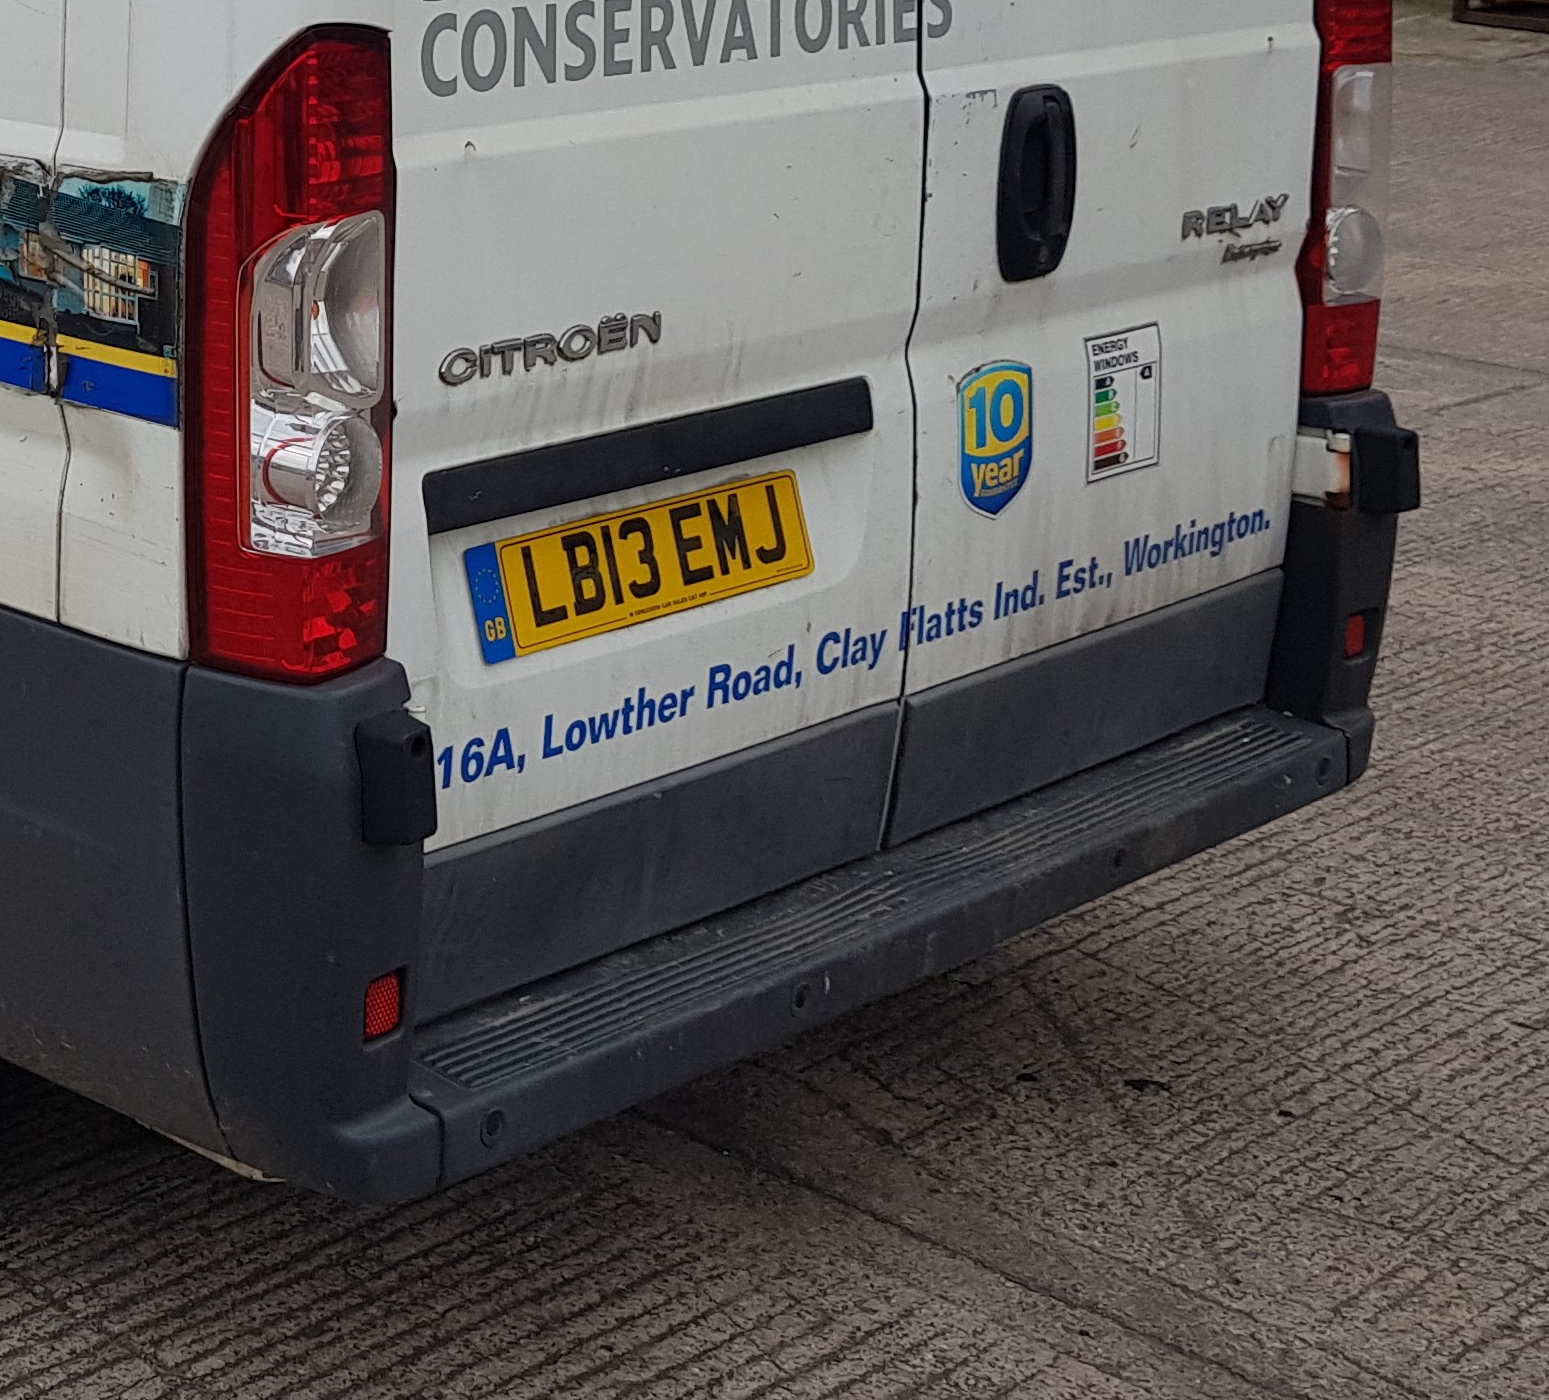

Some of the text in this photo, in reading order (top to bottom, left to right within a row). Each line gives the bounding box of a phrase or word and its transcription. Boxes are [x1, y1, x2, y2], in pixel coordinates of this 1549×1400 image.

[1181, 192, 1290, 241] RELAY
[438, 311, 662, 386] CITROËN
[1091, 337, 1129, 357] ENERGY
[1093, 350, 1140, 372] WINDOWS
[969, 378, 1024, 450] 10
[971, 448, 1025, 497] year
[520, 484, 788, 628] LB13 EMJ
[436, 507, 1271, 790] 16A, Lowther Road, Clay Flatts Ind. Est., Workington.
[483, 616, 507, 643] GB
